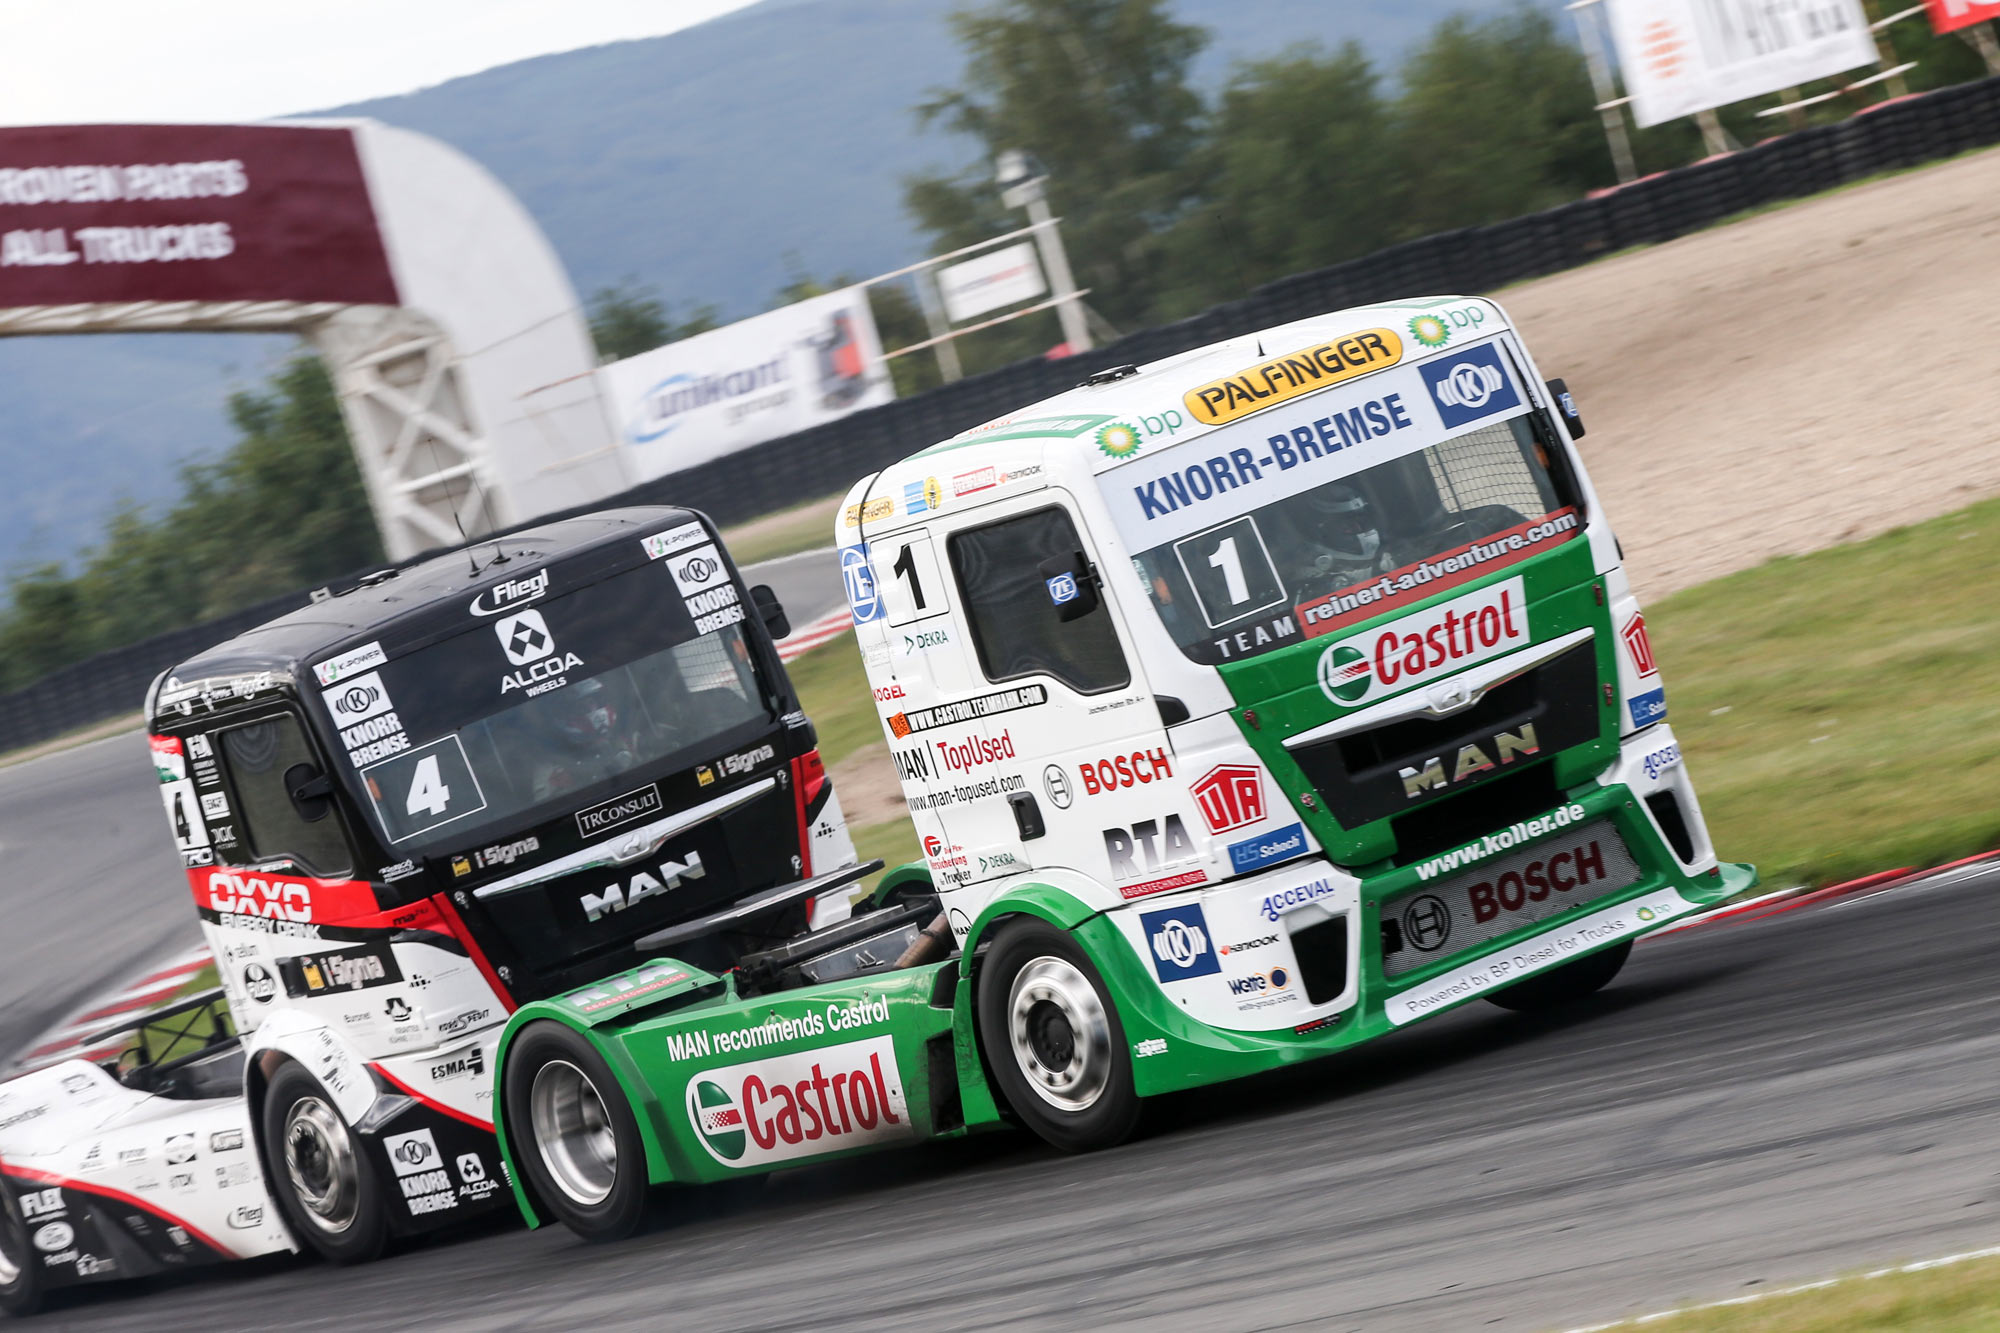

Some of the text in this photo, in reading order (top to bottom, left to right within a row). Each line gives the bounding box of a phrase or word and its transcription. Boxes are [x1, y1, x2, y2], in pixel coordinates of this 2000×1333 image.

[124, 159, 248, 199] PARTS
[1, 221, 235, 268] ALL TRUCKS
[1443, 303, 1485, 330] bp
[1196, 332, 1392, 418] PALFINGER
[1138, 408, 1183, 437] bp
[1133, 392, 1414, 521] KNORR-BREMSE
[492, 568, 551, 604] Fliegl
[893, 544, 927, 610] 1
[1050, 577, 1076, 601] ZF
[1208, 536, 1251, 606] 1
[1304, 510, 1578, 625] reinert-adventure.com
[684, 583, 740, 619] KNORR
[693, 604, 746, 636] BREMSE
[915, 628, 950, 650] DEKRA
[1215, 615, 1296, 659] TEAM
[1375, 589, 1520, 686] Castrol
[500, 650, 585, 695] ALCOA
[525, 675, 567, 698] WHEELS
[339, 711, 403, 750] KNORR
[907, 685, 1046, 732] WWW.CASTROLTEAMHAHN.COM
[348, 731, 412, 769] BREMSE
[936, 728, 1016, 774] TopUsed
[1079, 747, 1173, 796] BOSCH
[1398, 722, 1540, 799] MAN
[405, 753, 452, 817] 4
[1193, 765, 1267, 833] UTA
[174, 791, 191, 845] 4
[475, 835, 540, 869] i-Sigma
[988, 852, 1016, 869] DEKRA
[1102, 813, 1200, 882] RTA
[1415, 802, 1586, 881] www.koller.de
[208, 872, 312, 923] OXXO
[580, 850, 707, 923] MAN
[943, 868, 973, 886] Trucker
[1120, 871, 1207, 899] ABGASTECHNOLOGIE
[1260, 878, 1335, 921] ACCEVAL
[1467, 840, 1607, 925] BOSCH
[219, 912, 323, 940] ENERGY DRINK
[1405, 918, 1627, 1013] Powered by BP Diesel for Trucks
[666, 994, 890, 1062] MAN recommends Castrol
[430, 1059, 467, 1080] ESMA
[741, 1051, 900, 1150] Castrol
[399, 1168, 452, 1198] KNORR
[406, 1190, 459, 1217] BREMSE
[458, 1179, 500, 1197] ALCOA
